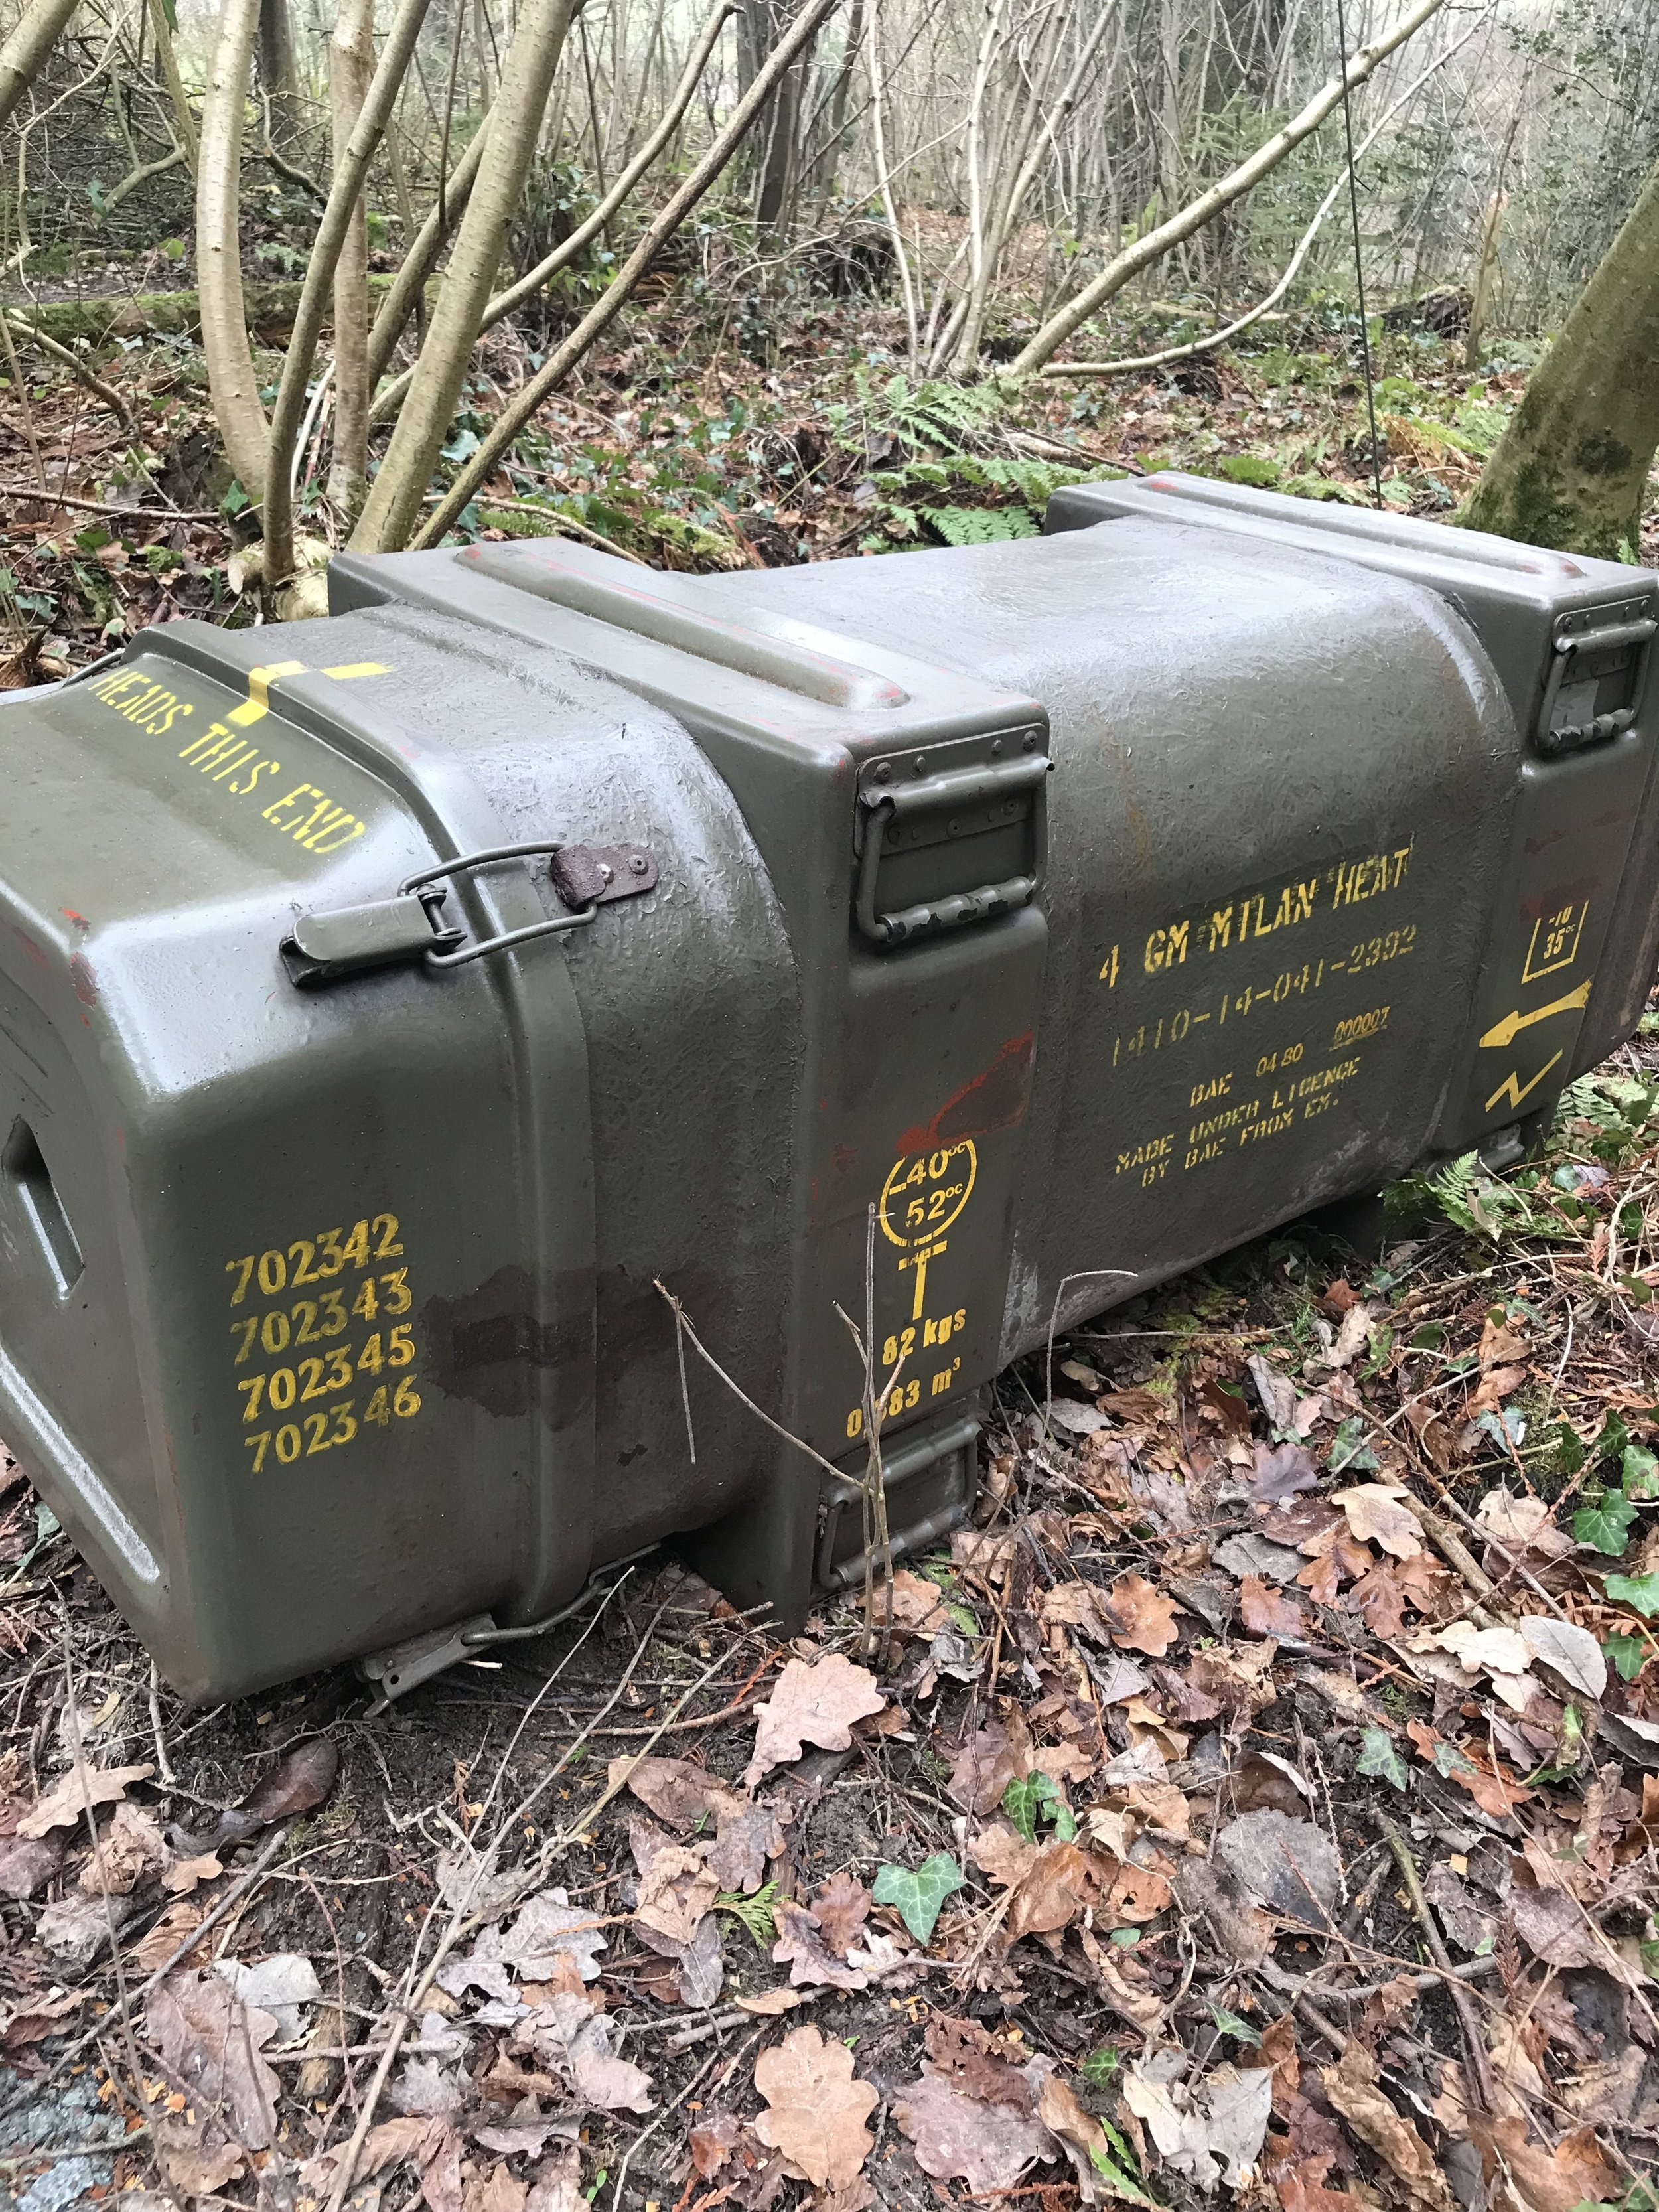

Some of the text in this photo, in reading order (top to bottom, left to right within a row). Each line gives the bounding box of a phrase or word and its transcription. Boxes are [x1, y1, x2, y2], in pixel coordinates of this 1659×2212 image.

[88, 668, 193, 735] HEADS
[178, 723, 281, 794] THIS
[261, 783, 366, 853] END
[1099, 847, 1411, 988] 4 GM MILAN HEAT
[1115, 1056, 1361, 1175] MADE UNDER LICENCE
[1190, 1072, 1233, 1108] BAE
[1141, 1159, 1170, 1188] BY
[1184, 1137, 1227, 1170] BAE
[1239, 1108, 1294, 1147] FROM
[224, 1213, 405, 1308] 702342
[230, 1267, 413, 1366] 702343
[882, 1308, 966, 1366] 82 kgs
[238, 1323, 416, 1424] 702345
[244, 1374, 422, 1474] 702346
